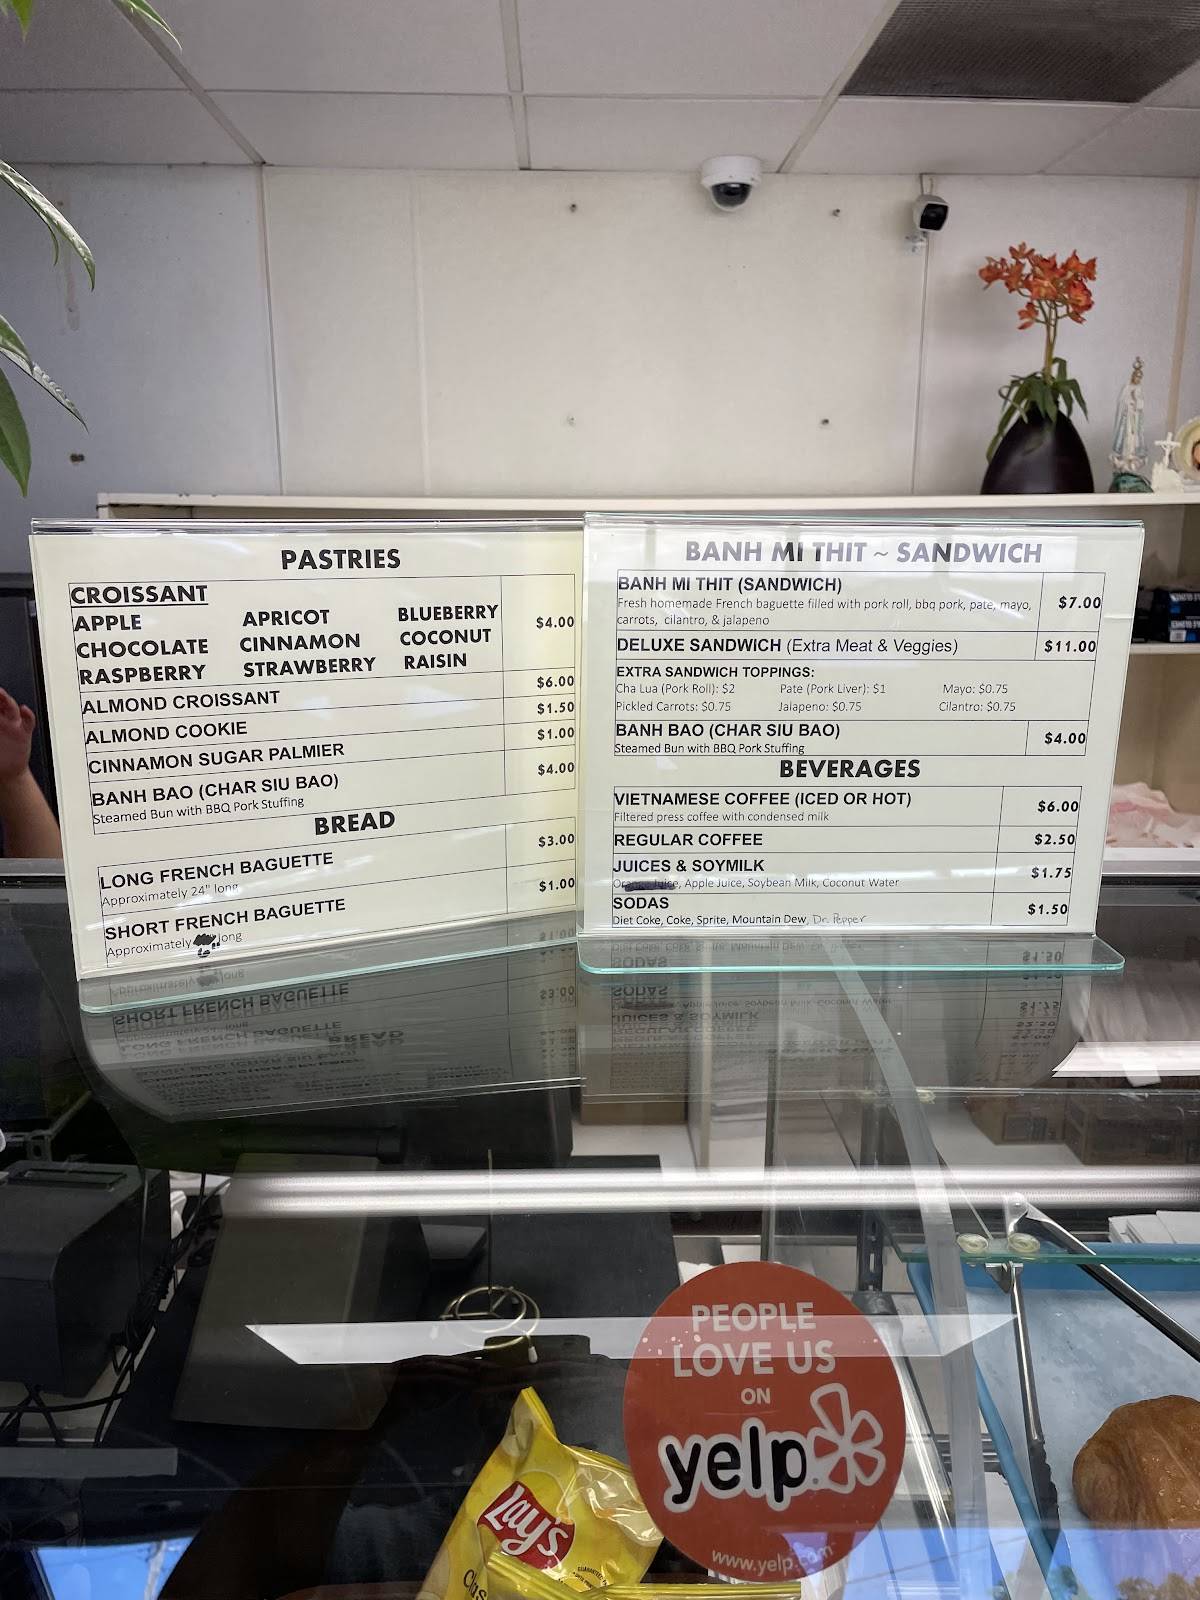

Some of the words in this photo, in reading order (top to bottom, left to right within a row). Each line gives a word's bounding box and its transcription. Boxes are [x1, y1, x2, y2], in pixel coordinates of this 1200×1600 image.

[281, 548, 401, 570] PASTRIES
[686, 541, 763, 562] BANH
[772, 542, 804, 562] MI
[814, 542, 867, 562] THIT
[897, 542, 1042, 563] SANDWICH
[618, 576, 667, 591] BANH
[672, 577, 691, 591] MI
[697, 577, 733, 592] THIT
[738, 576, 842, 595] (SANDWICH)
[70, 584, 208, 605] CROISSANT
[1058, 595, 1101, 610] $7.00
[398, 604, 499, 622] BLUEBERRY
[618, 598, 645, 609] Fresh
[650, 598, 712, 609] homemade
[716, 598, 753, 609] French
[757, 598, 803, 612] baguette
[807, 598, 834, 609] filled
[839, 598, 861, 609] with
[864, 599, 888, 612] pork
[915, 599, 935, 612] bbq
[938, 599, 966, 612] pork,
[74, 614, 142, 632] APPLE
[243, 609, 330, 627] APRICOT
[536, 615, 575, 630] $4.00
[617, 615, 658, 627] carrots,
[665, 615, 708, 627] cilantro,
[712, 615, 720, 626] &
[723, 615, 770, 629] jalapeno
[240, 633, 361, 653] CINNAMON
[400, 628, 492, 646] COCONUT
[77, 638, 209, 659] CHOCOLATE
[617, 637, 684, 652] DELUXE
[690, 637, 781, 653] SANDWICH
[787, 637, 830, 655] (Extra
[836, 638, 873, 653] Meat
[878, 639, 888, 653] &
[893, 638, 958, 656] Veggies)
[1044, 640, 1096, 654] $11.00
[243, 656, 376, 678] STRAWBERRY
[404, 653, 467, 670] RAISIN
[80, 665, 206, 686] RASPBERRY
[616, 666, 660, 677] EXTRA
[665, 666, 738, 677] SANDWICH
[743, 666, 815, 678] TOPPINGS:
[537, 674, 575, 689] $6.00
[616, 684, 637, 694] Cha
[640, 684, 658, 694] Lua
[661, 683, 688, 695] (Pork
[692, 683, 718, 695] Roll):
[722, 683, 735, 695] $2
[780, 684, 803, 694] Pate
[807, 683, 832, 696] (Pork
[837, 683, 869, 696] Liver):
[872, 683, 885, 695] $1
[943, 683, 975, 696] Mayo:
[979, 683, 1008, 695] $0.75
[83, 696, 168, 715] ALMOND
[173, 690, 280, 709] CROISSANT
[537, 701, 575, 715] $1.50
[616, 702, 653, 712] Pickled
[656, 702, 698, 712] Carrots:
[702, 702, 731, 713] $0.75
[779, 702, 828, 714] Jalapeno:
[832, 702, 862, 713] $0.75
[939, 702, 983, 712] Cilantro:
[986, 701, 1016, 713] $0.75
[86, 725, 170, 745] ALMOND
[175, 720, 247, 739] COOKIE
[537, 727, 575, 741] $1.00
[616, 723, 663, 737] BANH
[668, 723, 704, 737] BAO
[709, 723, 761, 740] (CHAR
[765, 723, 794, 737] SIU
[798, 723, 840, 740] BAO)
[1044, 732, 1086, 746] $4.00
[615, 743, 660, 754] Steamed
[664, 743, 684, 754] Bun
[687, 743, 710, 754] with
[713, 743, 736, 755] BBQ
[739, 743, 760, 754] Pork
[763, 742, 804, 756] Stuffing
[88, 752, 194, 775] CINNAMON
[198, 748, 264, 765] SUGAR
[269, 742, 345, 760] PALMIER
[537, 761, 575, 776] $4.00
[780, 759, 921, 778] BEVERAGES
[92, 788, 147, 807] BANH
[152, 785, 194, 802] BAO
[199, 780, 257, 802] (CHAR
[261, 776, 290, 793] SIU
[295, 772, 339, 790] BAO)
[615, 792, 719, 806] VIETNAMESE
[724, 792, 789, 807] COFFEE
[795, 792, 838, 809] (ICED
[843, 792, 868, 806] OR
[872, 792, 912, 809] HOT)
[1037, 800, 1079, 814] $6.00
[93, 810, 147, 824] Steamed
[150, 808, 174, 819] Bun
[177, 805, 202, 817] with
[206, 801, 231, 815] BBQ
[235, 799, 259, 811] Pork
[262, 795, 304, 810] Stuffing
[614, 811, 654, 822] Filtered
[658, 813, 684, 822] press
[687, 811, 718, 822] coffee
[721, 811, 744, 822] with
[747, 811, 804, 822] condensed
[808, 811, 829, 822] milk
[315, 810, 396, 835] BREAD
[538, 833, 575, 847] $3.00
[614, 833, 693, 847] REGULAR
[698, 833, 763, 846] COFFEE
[1034, 833, 1075, 846] $2.50
[100, 871, 154, 890] LONG
[160, 861, 235, 882] FRENCH
[240, 851, 334, 875] BAGUETTE
[613, 859, 671, 873] JUICES
[675, 860, 687, 873] &
[692, 859, 765, 873] SOYMILK
[1031, 866, 1072, 879] $1.75
[539, 877, 575, 892] $1.00
[685, 878, 714, 890] Apple
[716, 878, 745, 889] Juice,
[748, 878, 791, 889] Soybean
[794, 878, 819, 889] Milk,
[822, 878, 865, 888] Coconut
[868, 878, 899, 888] Water
[102, 887, 188, 907] Approximately
[613, 897, 669, 910] SODAS
[1028, 903, 1068, 916] $1.50
[105, 919, 170, 940] SHORT
[175, 911, 249, 932] FRENCH
[253, 898, 346, 922] BAGUETTE
[613, 915, 633, 926] Diet
[636, 914, 662, 927] Coke,
[666, 914, 692, 927] Coke,
[696, 914, 728, 928] Sprite,
[732, 913, 781, 925] Mountain
[107, 938, 192, 959] Approximately
[692, 1302, 816, 1332] PEOPLE
[673, 1342, 773, 1377] LOVE
[787, 1340, 835, 1374] US
[741, 1388, 770, 1404] ON
[665, 1425, 807, 1504] yelp
[484, 1485, 568, 1556] Lay's
